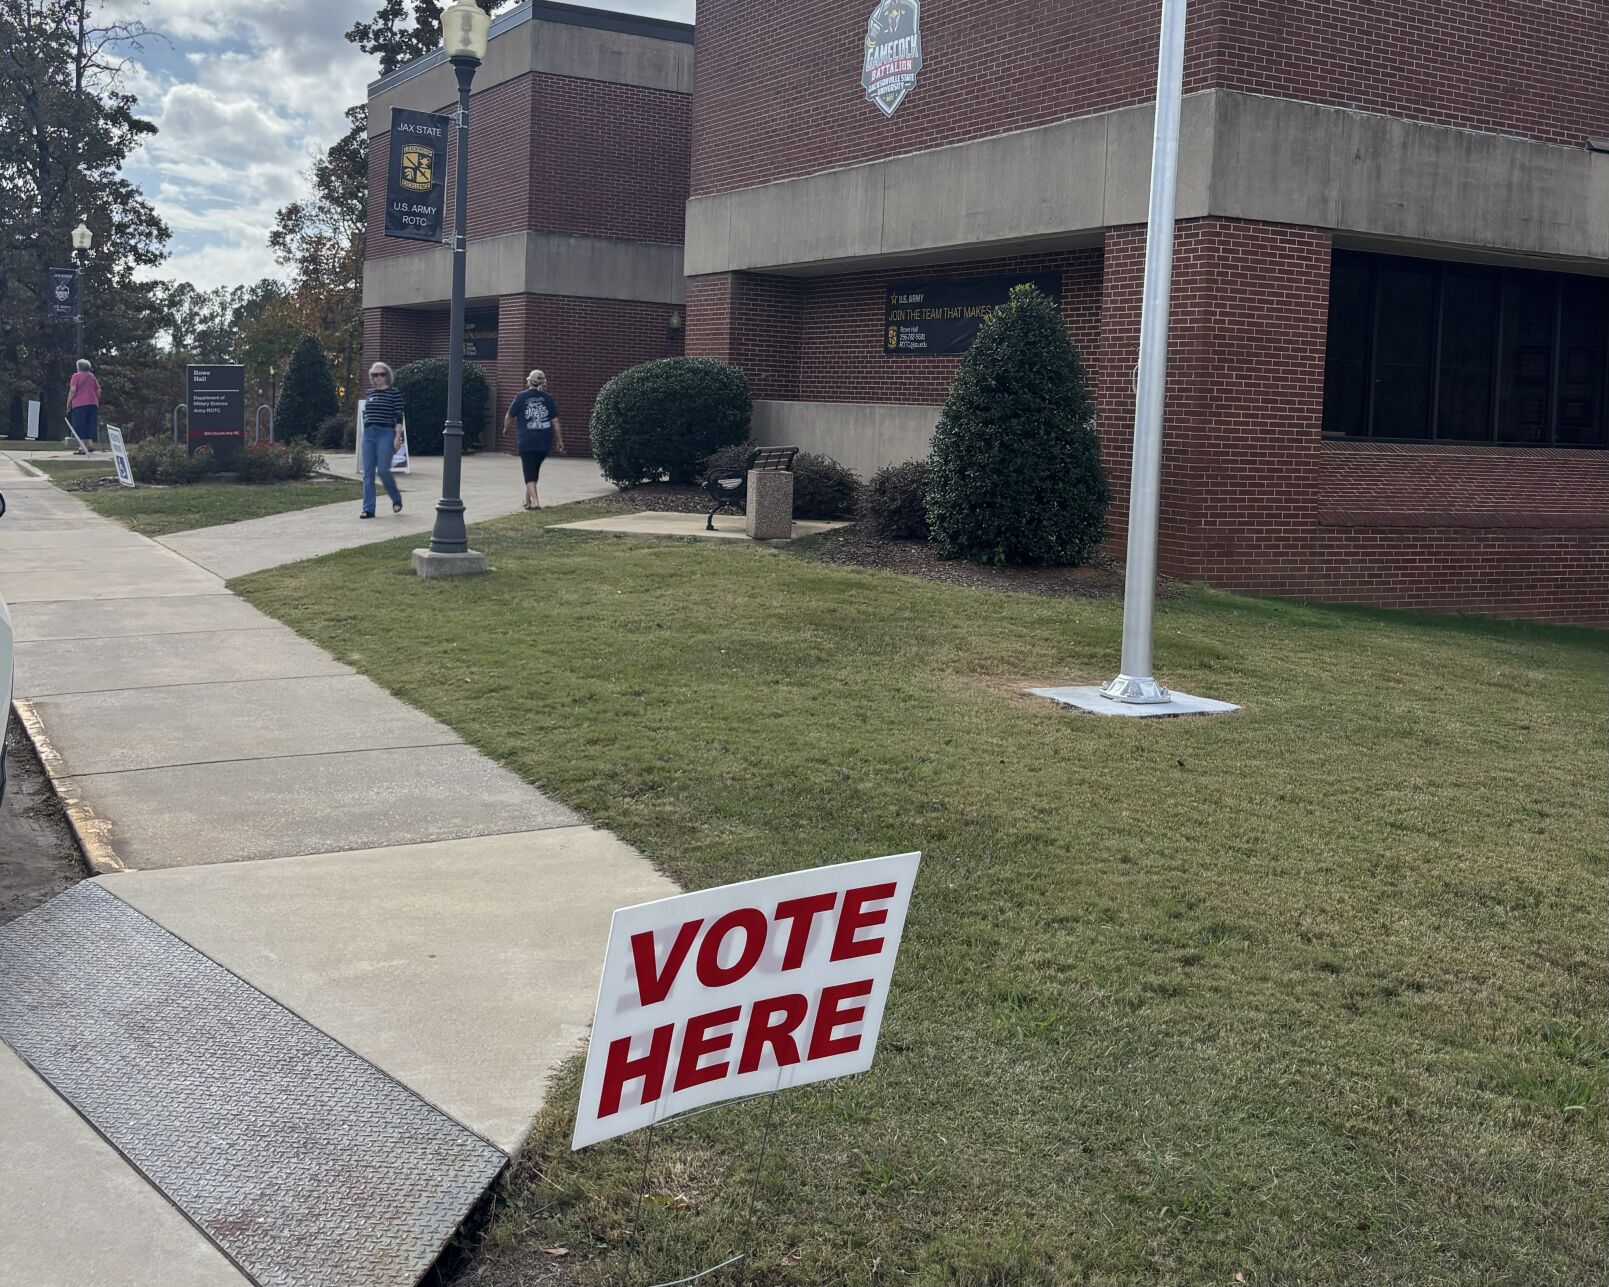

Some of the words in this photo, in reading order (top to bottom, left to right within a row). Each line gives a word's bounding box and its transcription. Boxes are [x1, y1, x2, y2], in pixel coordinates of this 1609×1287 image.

[866, 33, 918, 71] GAMECOCK
[871, 59, 912, 82] BATTALION
[397, 123, 415, 133] JAX
[416, 125, 442, 137] STATE
[393, 202, 410, 212] U.S.
[411, 204, 437, 216] ARMY
[402, 216, 427, 226] ROTC
[899, 294, 908, 304] U.S.
[908, 293, 925, 303] ARMY
[888, 309, 905, 322] JOIN
[906, 308, 921, 321] THE
[922, 307, 942, 320] TEAM
[943, 306, 963, 319] THAT
[963, 304, 992, 318] MAKES
[631, 882, 897, 1007] VOTE
[597, 979, 874, 1119] HERE
